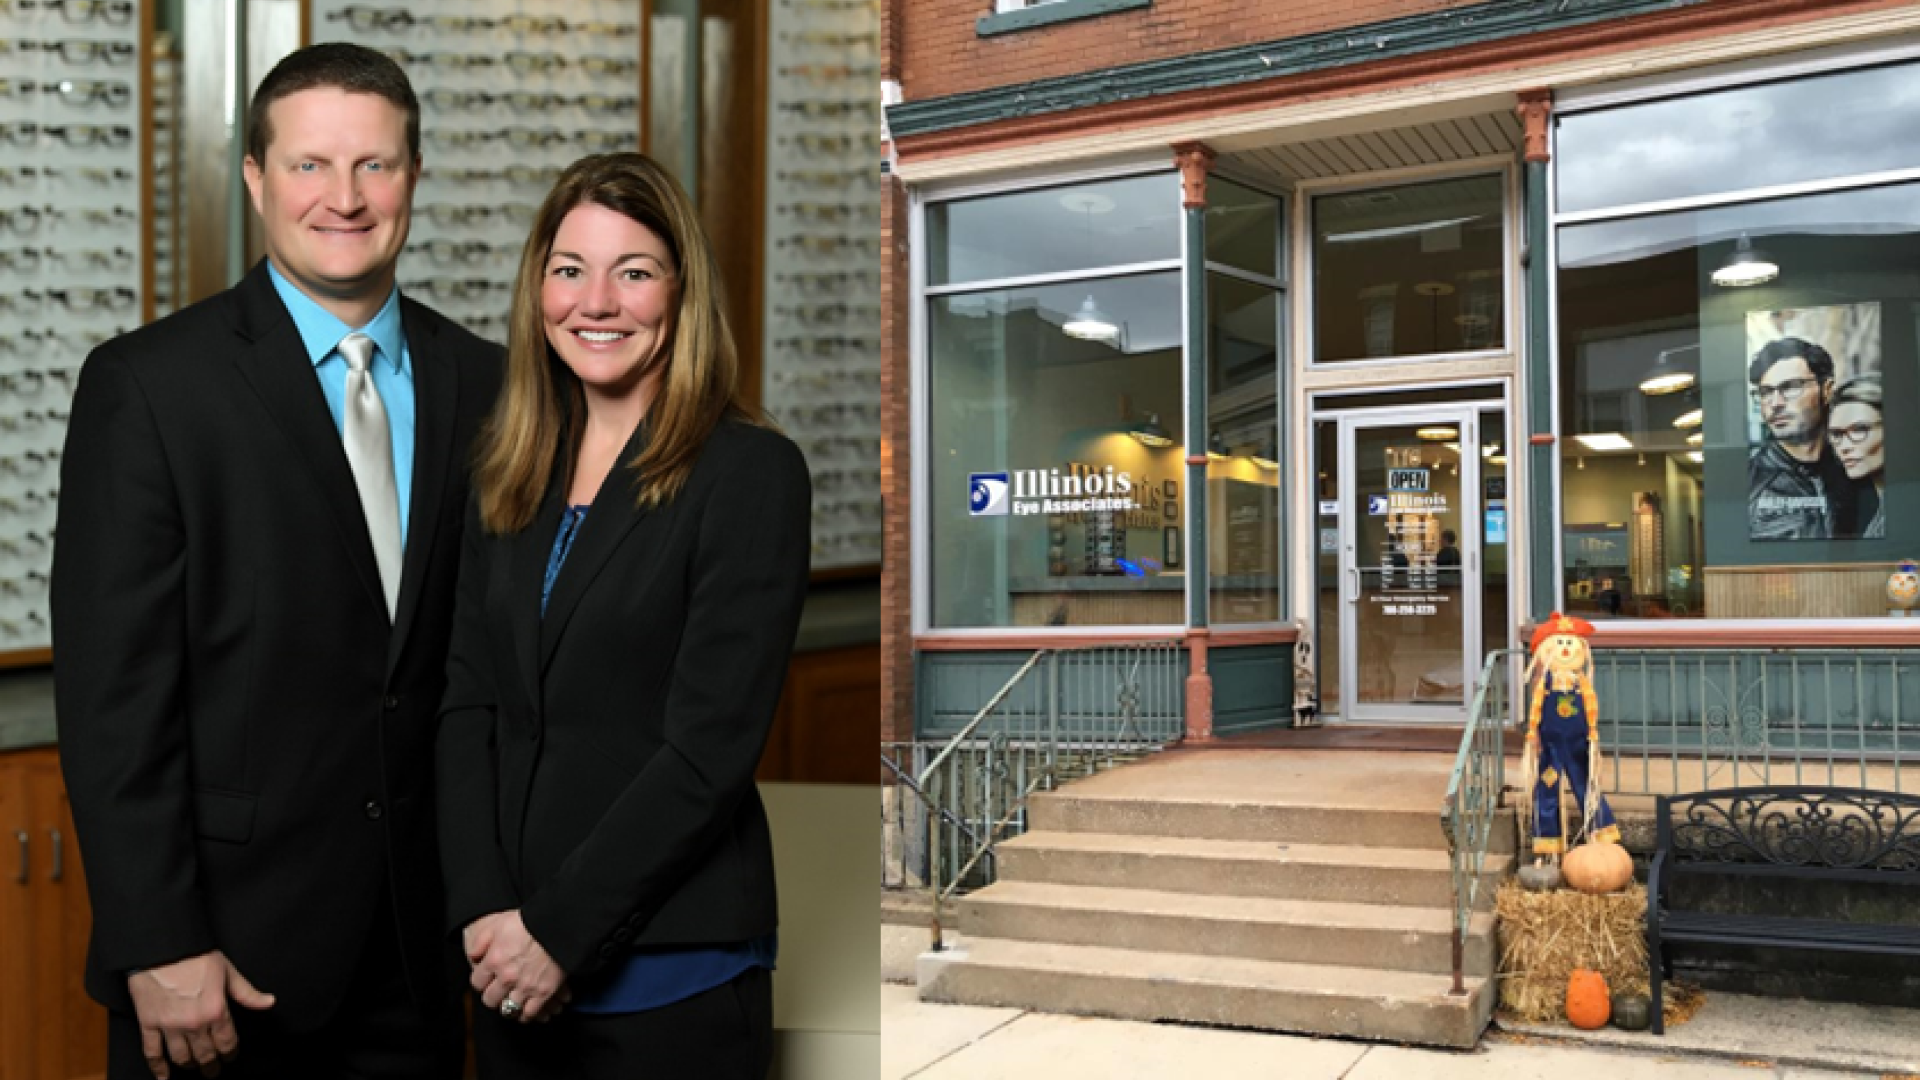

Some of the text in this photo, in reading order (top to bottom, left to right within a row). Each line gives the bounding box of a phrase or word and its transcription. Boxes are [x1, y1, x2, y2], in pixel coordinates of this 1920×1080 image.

[1012, 465, 1131, 498] Illinois
[1391, 471, 1426, 489] OPEN
[1012, 497, 1133, 515] Eye Associates
[1389, 492, 1447, 508] Illinois
